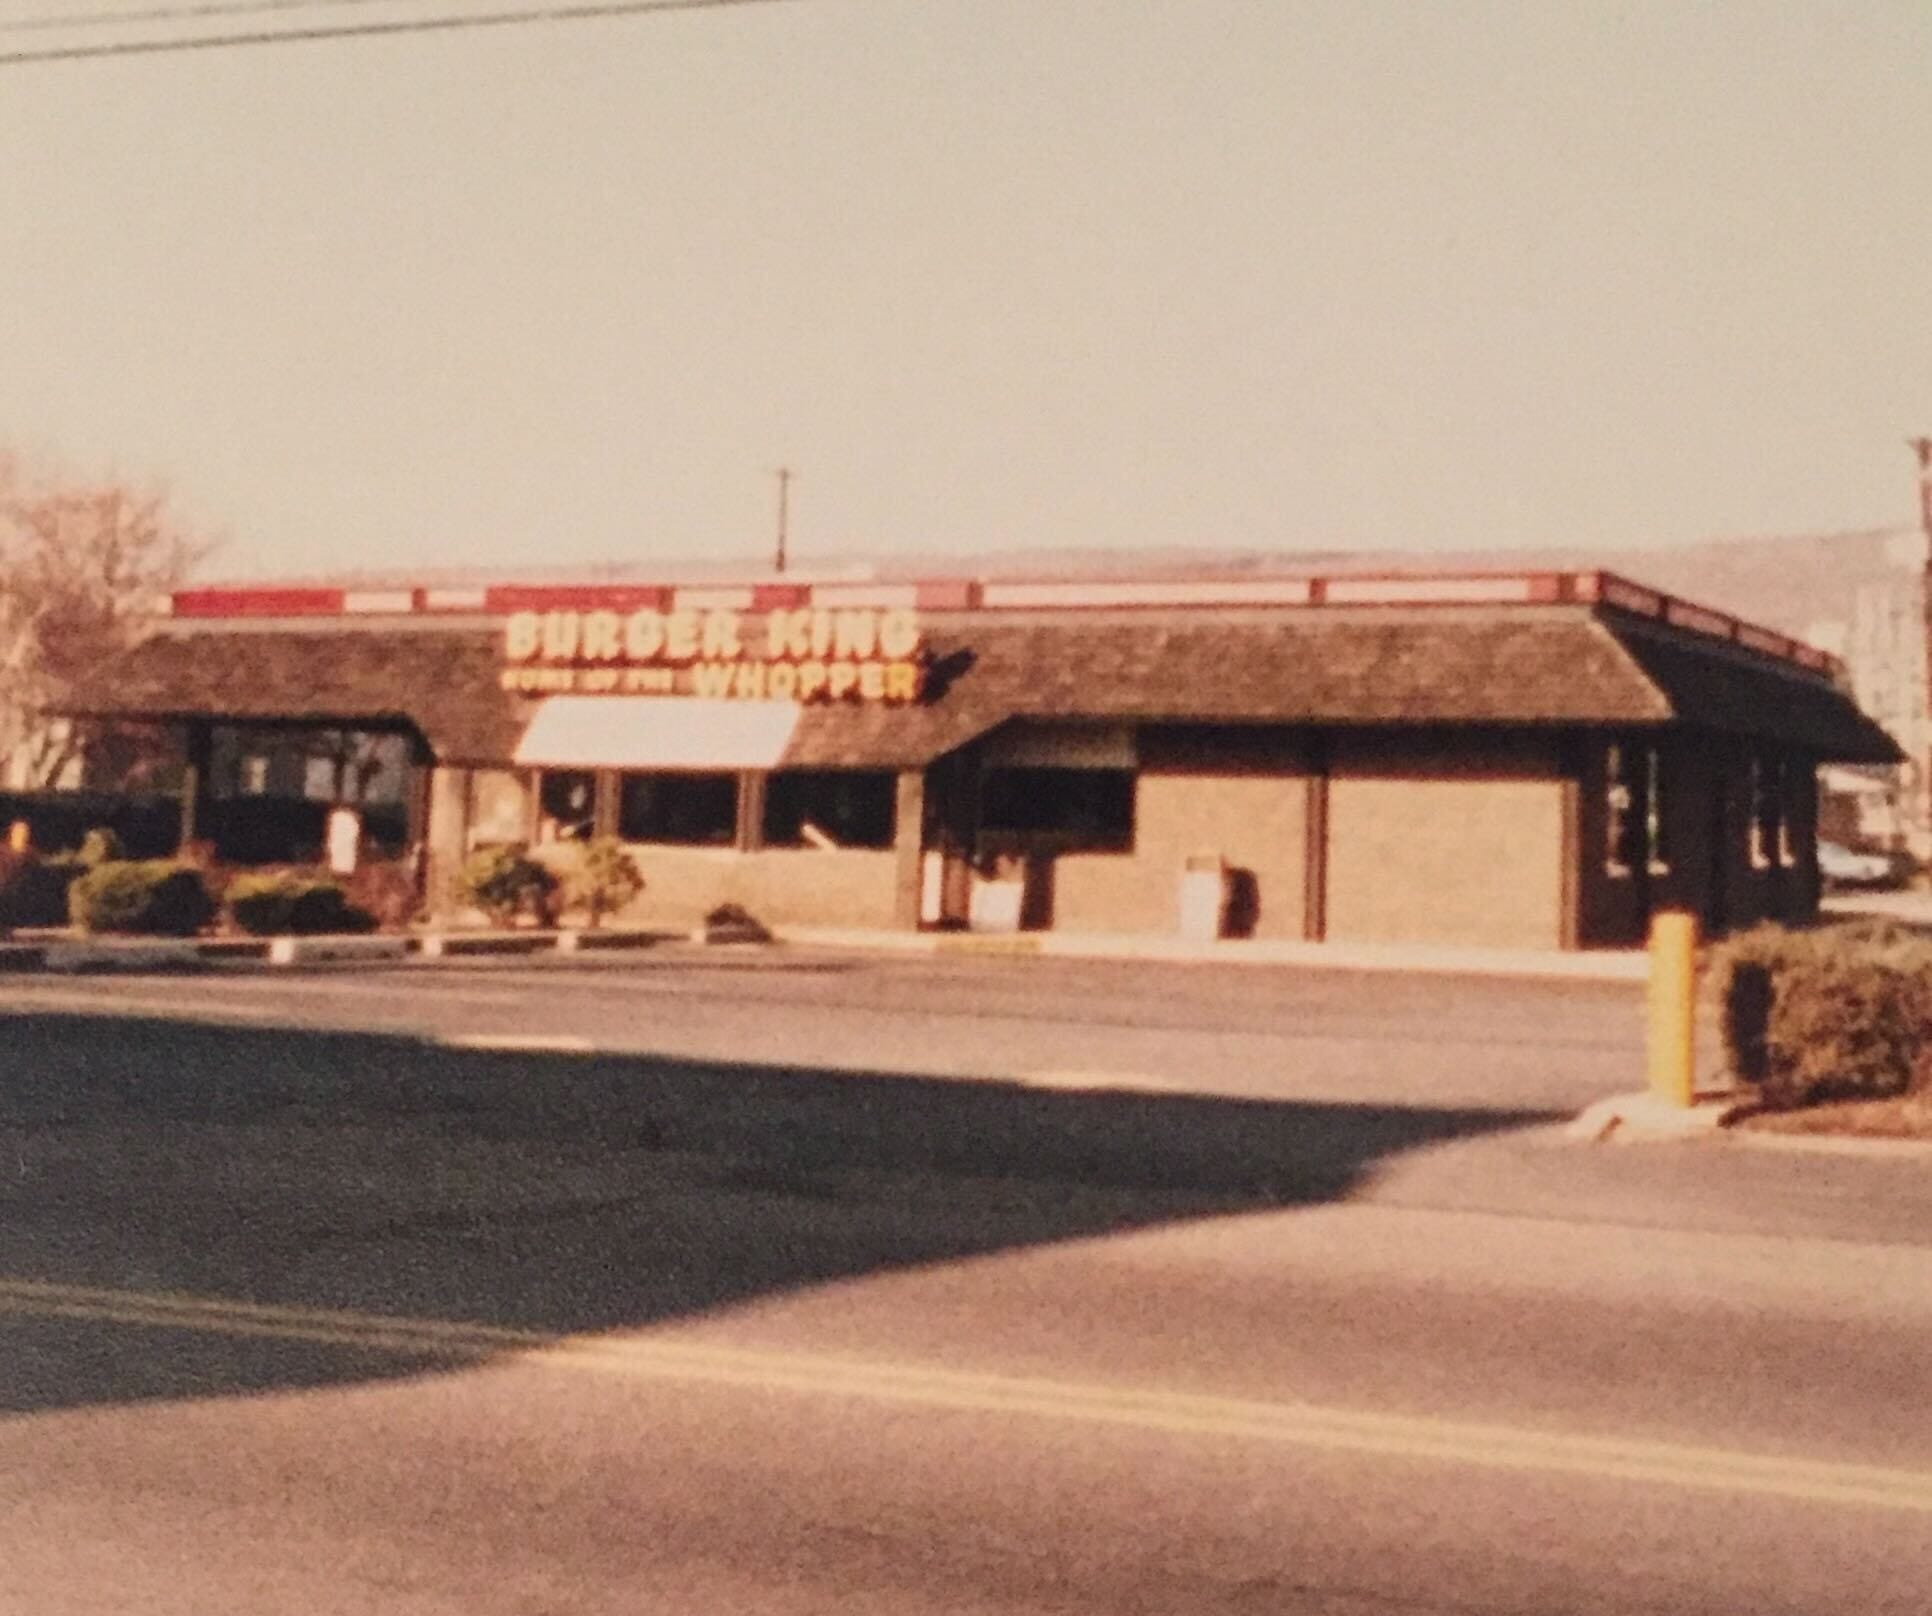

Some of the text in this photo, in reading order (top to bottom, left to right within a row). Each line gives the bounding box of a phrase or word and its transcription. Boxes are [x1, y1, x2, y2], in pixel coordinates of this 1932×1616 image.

[506, 609, 919, 660] BURGER KING
[693, 662, 916, 700] WHOPPER
